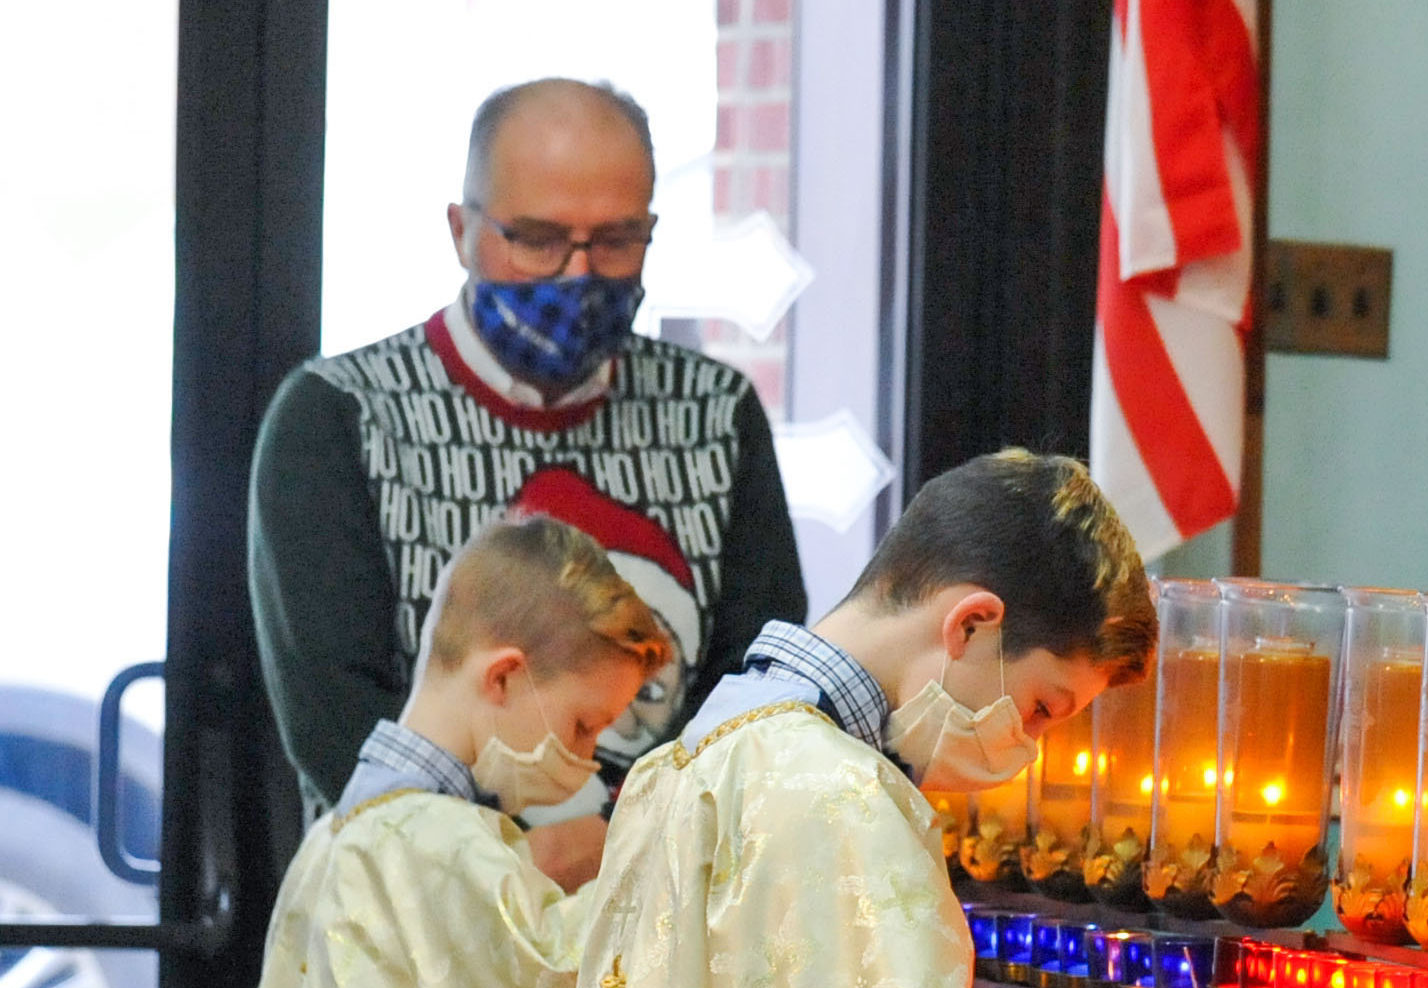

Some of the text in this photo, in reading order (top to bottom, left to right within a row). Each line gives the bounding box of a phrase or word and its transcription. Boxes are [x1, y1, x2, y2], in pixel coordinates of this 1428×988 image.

[402, 393, 451, 444] HO
[453, 395, 505, 445] HO
[612, 402, 652, 449] HO
[658, 402, 700, 446] HO
[440, 446, 486, 500] HO
[592, 452, 639, 504] HO
[640, 449, 683, 504] HO
[684, 442, 732, 500] HO
[381, 480, 421, 542] HO
[422, 498, 462, 551] HO
[673, 503, 721, 558] HO
[401, 544, 444, 599] HO
